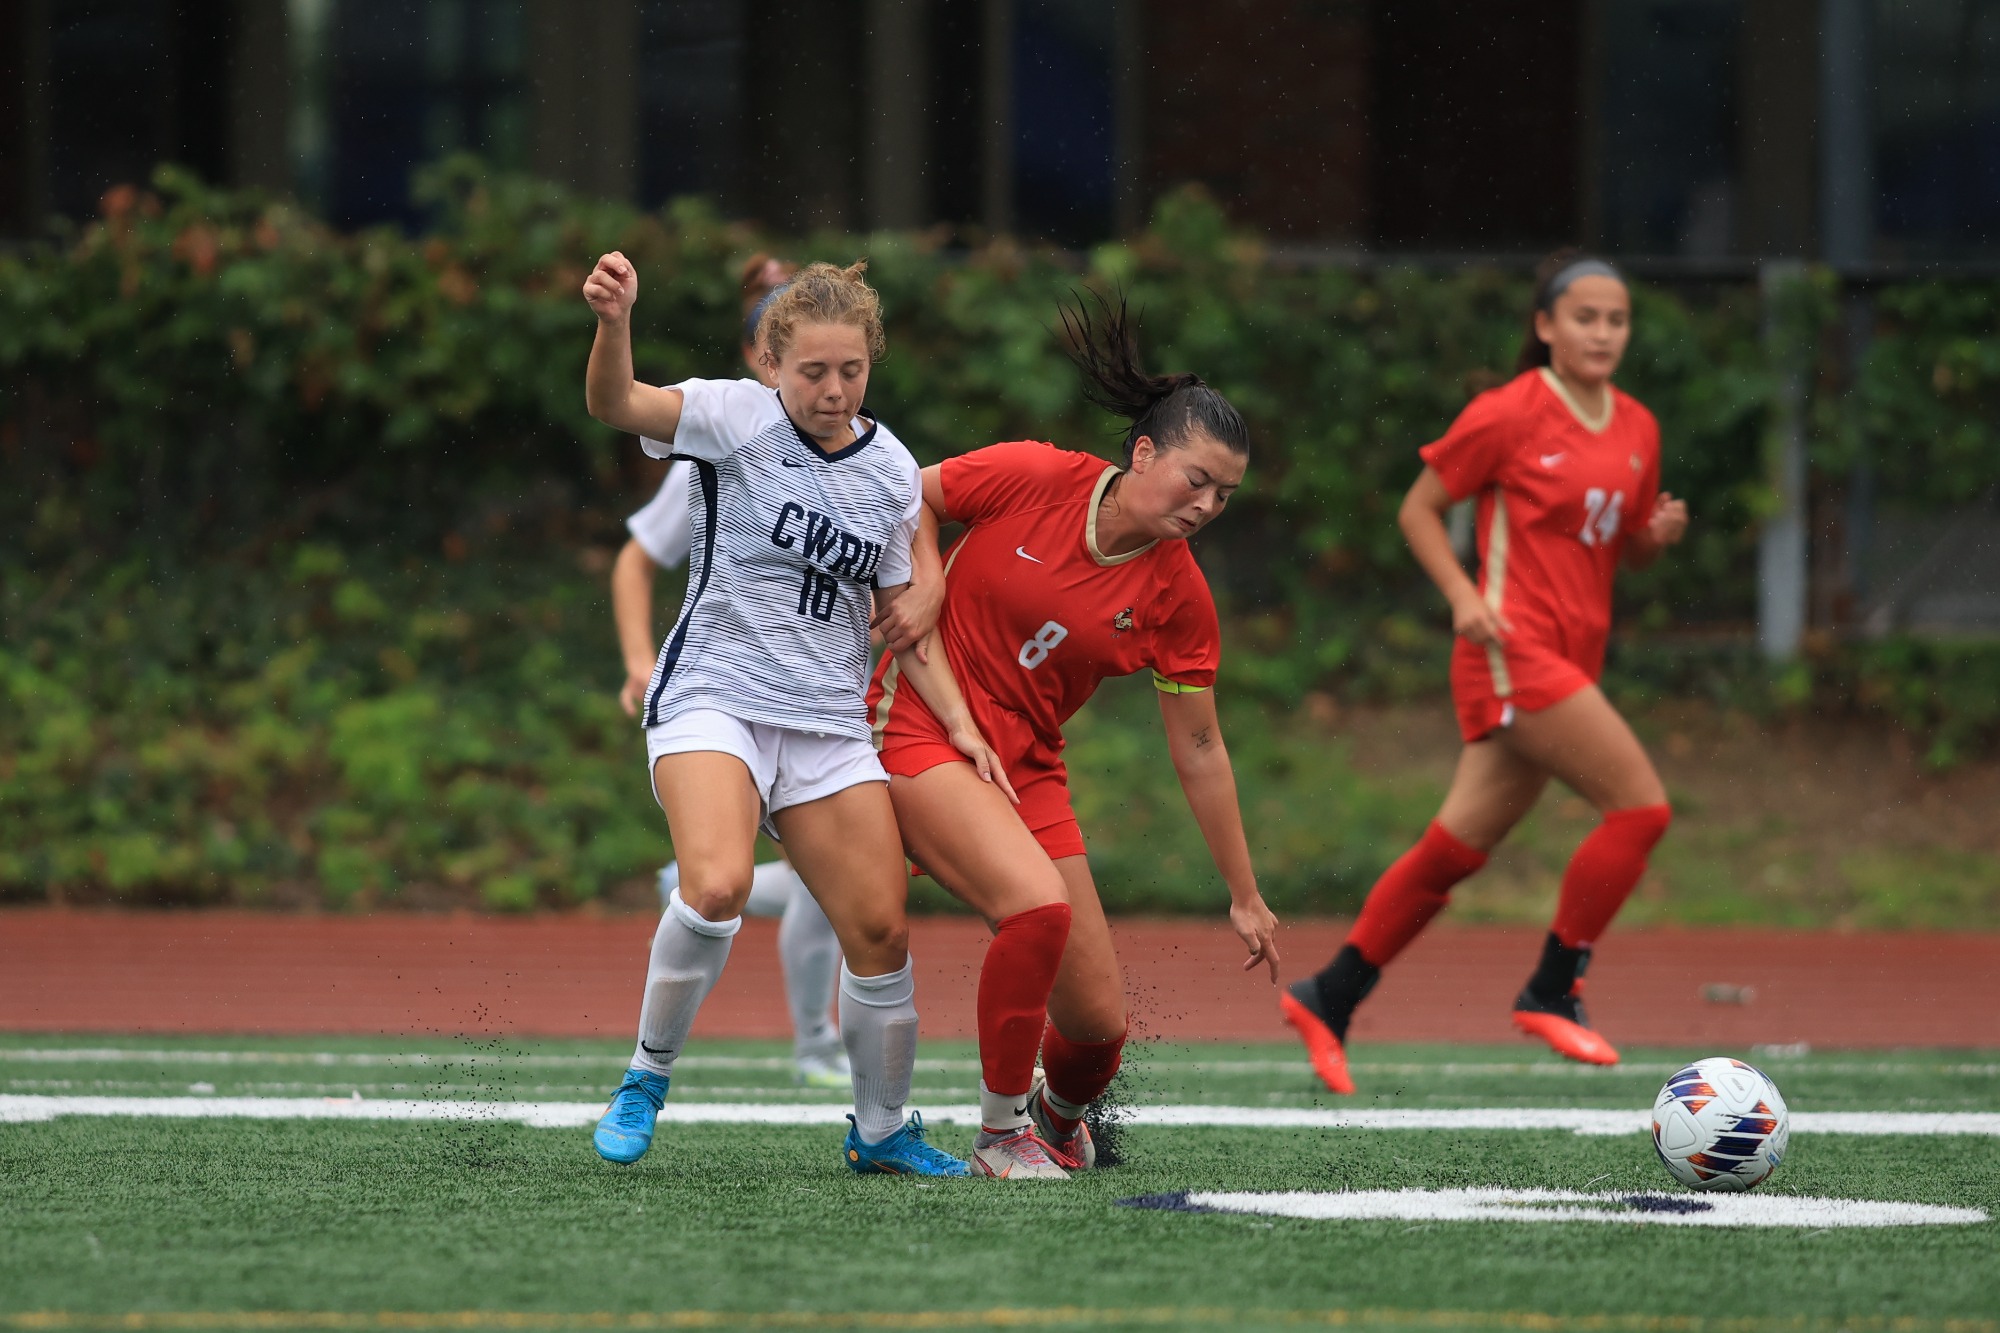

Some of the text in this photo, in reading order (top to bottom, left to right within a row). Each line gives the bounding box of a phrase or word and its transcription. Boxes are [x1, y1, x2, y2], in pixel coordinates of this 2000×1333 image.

[772, 502, 881, 584] CWRU
[1580, 488, 1624, 545] 24
[1018, 620, 1068, 670] 8
